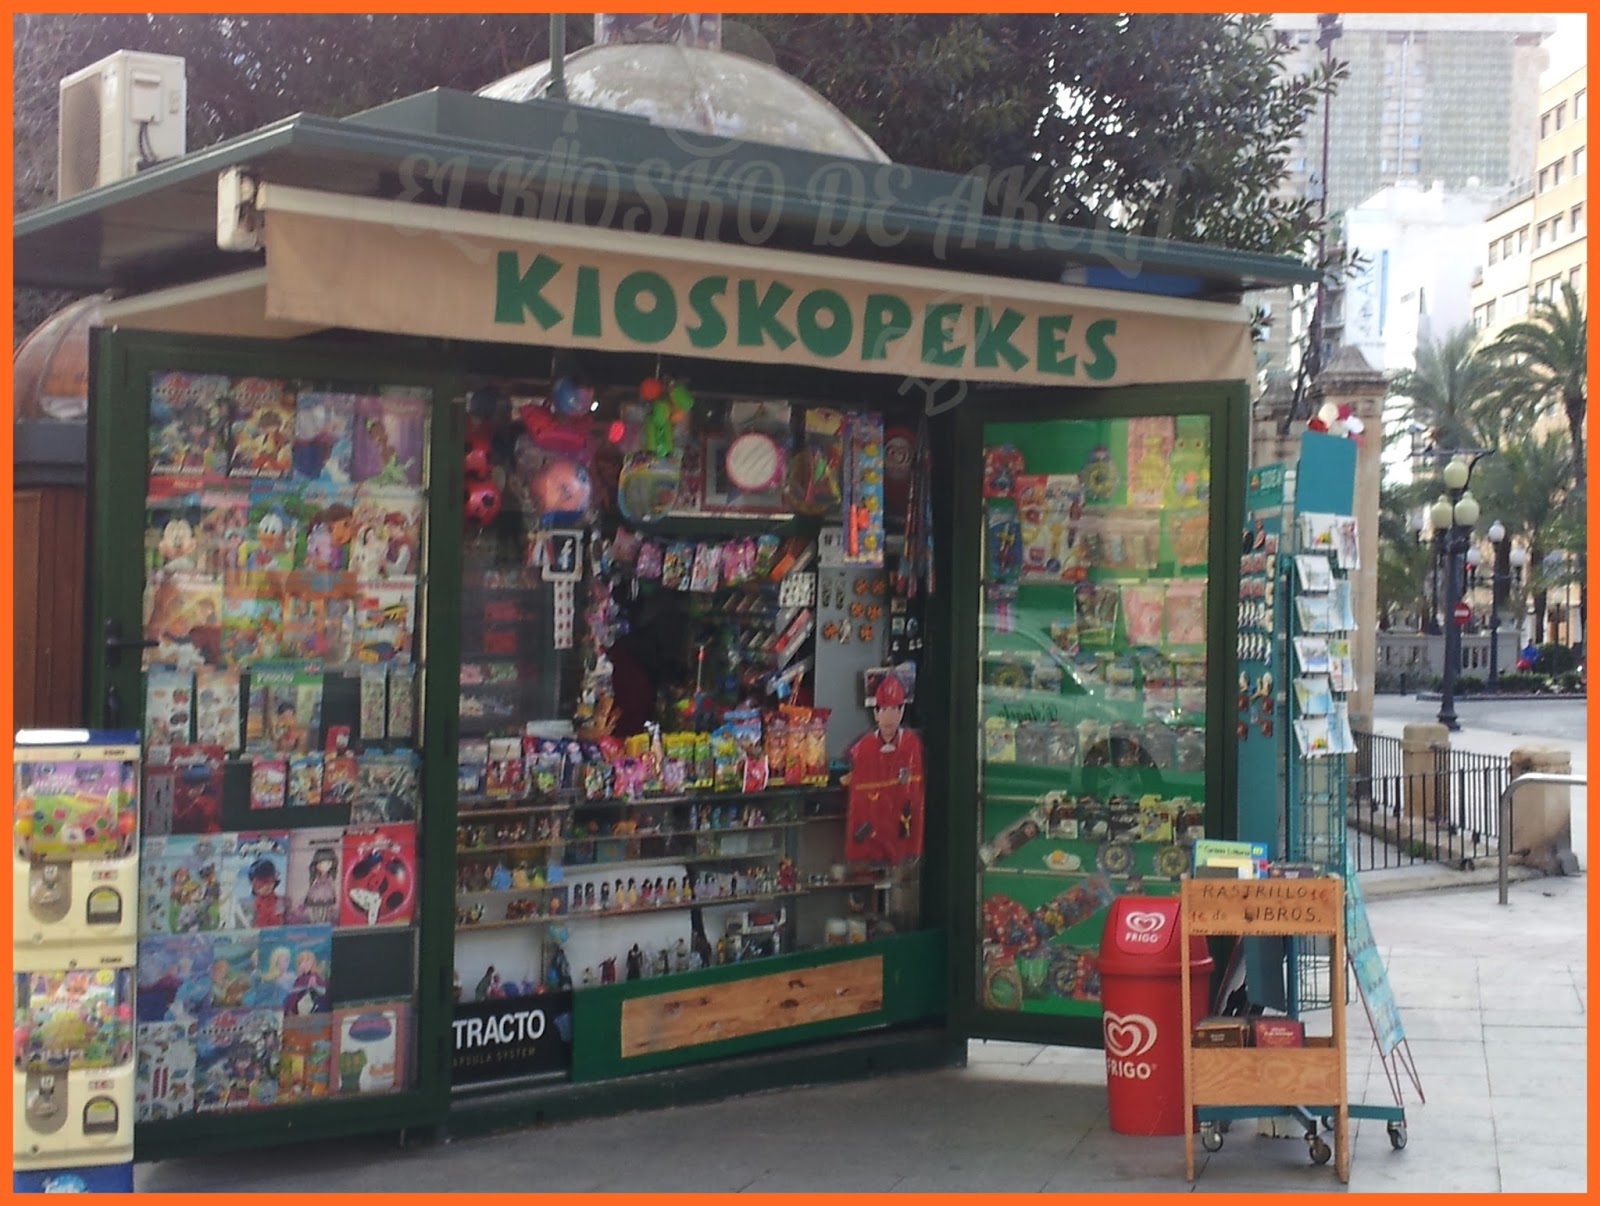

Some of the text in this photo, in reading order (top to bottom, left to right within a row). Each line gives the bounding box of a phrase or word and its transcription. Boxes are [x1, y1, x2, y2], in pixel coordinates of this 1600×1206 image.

[494, 250, 1118, 380] KIOSKOPEKES
[1203, 884, 1307, 900] RASTRILLO
[1125, 932, 1158, 944] FRIGO
[452, 1009, 546, 1050] TRACTO
[1107, 1060, 1151, 1080] FRIGO
